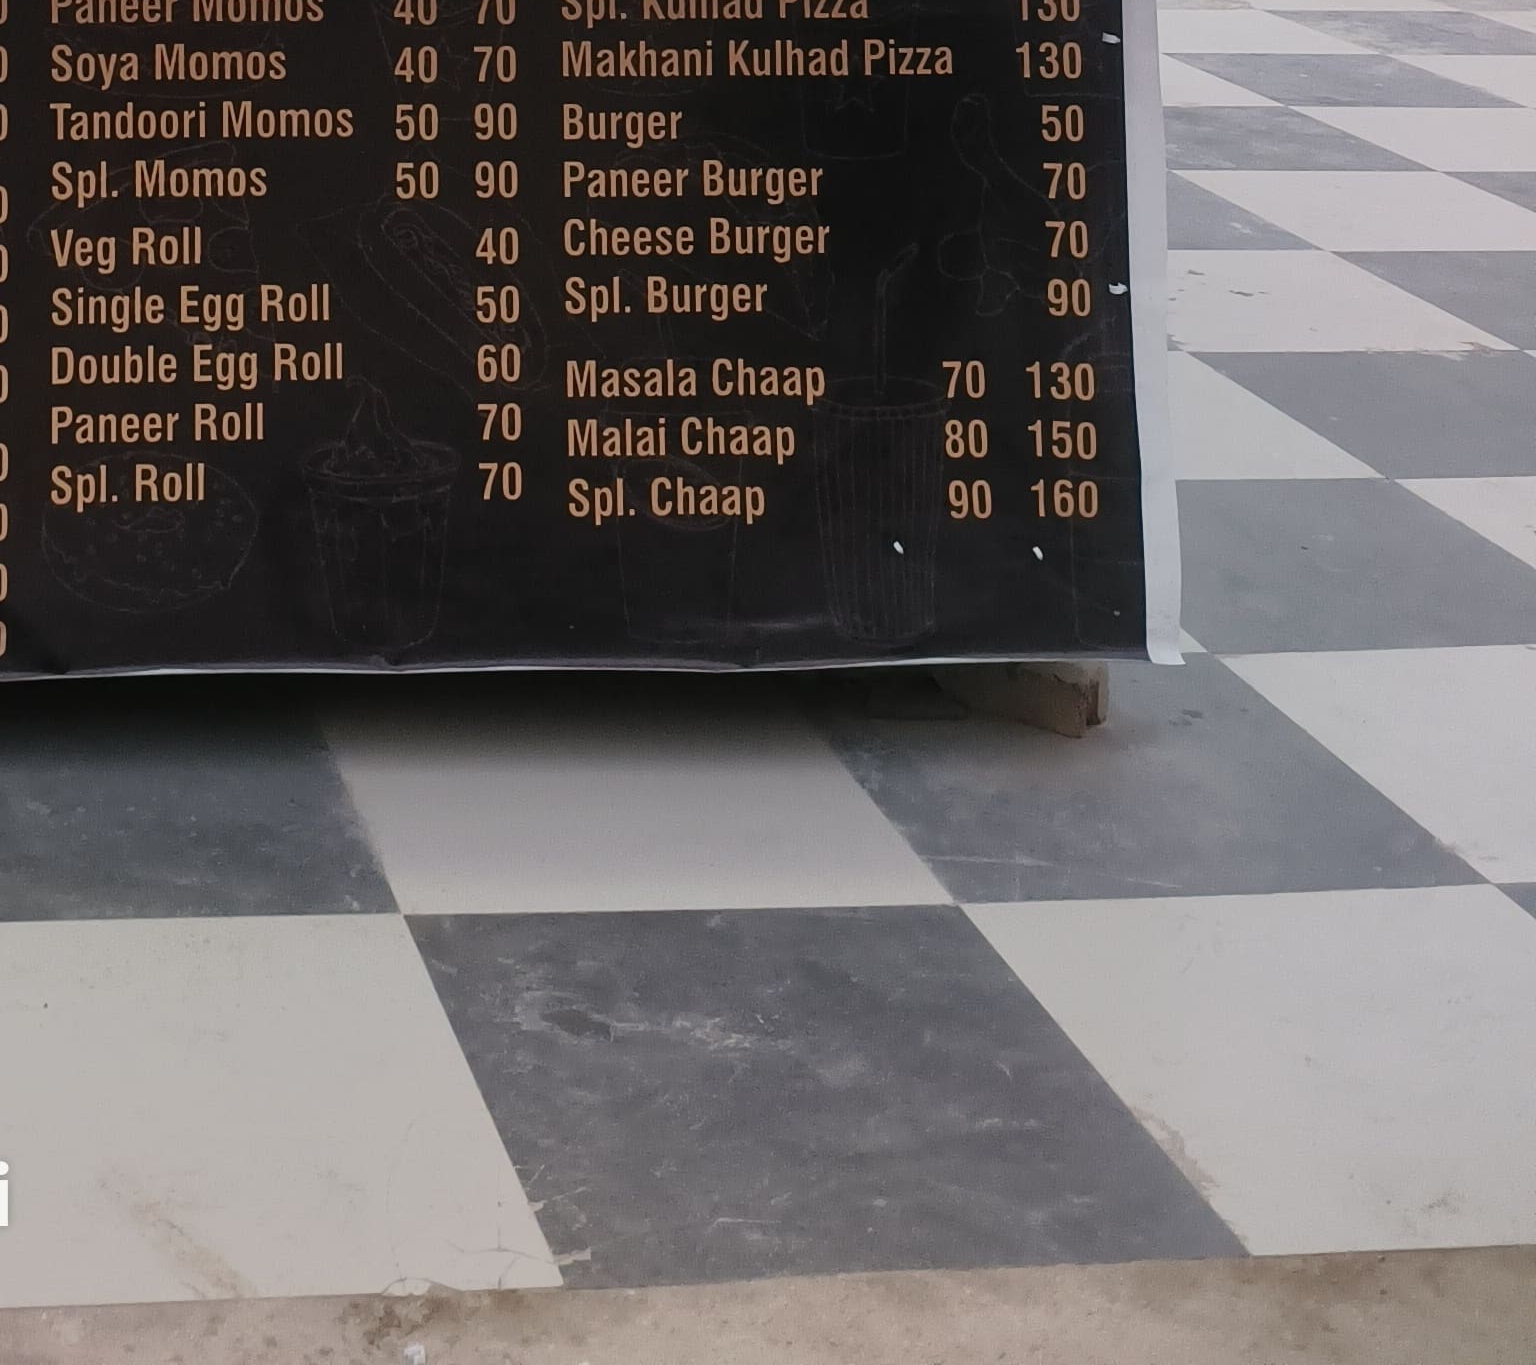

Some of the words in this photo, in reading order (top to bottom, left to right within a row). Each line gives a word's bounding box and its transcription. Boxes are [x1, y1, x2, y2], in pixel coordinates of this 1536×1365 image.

[563, 41, 712, 77] Makhani
[729, 40, 848, 76] Kulhad
[865, 40, 952, 75] Pizza
[1016, 42, 1081, 78] 130
[50, 102, 205, 140] Tandoori
[223, 101, 353, 137] Momos
[396, 104, 438, 141] 50
[474, 103, 517, 140] 90
[564, 104, 682, 148] Burger
[1042, 105, 1083, 141] 50
[52, 161, 118, 208] Spl.
[135, 160, 266, 197] Momos
[397, 162, 438, 199] 50
[475, 161, 517, 198] 90
[564, 162, 688, 197] Paneer
[703, 160, 823, 204] Burger
[1043, 163, 1085, 199] 70
[51, 229, 115, 274] Veg
[133, 226, 201, 265] Roll
[476, 227, 518, 264] 40
[565, 277, 630, 322] Spl.
[648, 276, 767, 321] Burger
[1048, 279, 1090, 316] 90
[52, 345, 176, 384] Double
[194, 344, 257, 390] Egg
[274, 343, 342, 381] Roll
[478, 344, 520, 382] 60
[568, 418, 665, 456] Malai
[682, 417, 794, 465] Chaap
[945, 420, 987, 458] 80
[1028, 421, 1096, 459] 150
[51, 465, 117, 513] Spl.
[136, 463, 204, 501] Roll
[479, 462, 521, 500] 70
[569, 478, 635, 525] Spl.
[651, 477, 764, 524] Chaap
[949, 480, 991, 518] 90
[1031, 480, 1098, 517] 160
